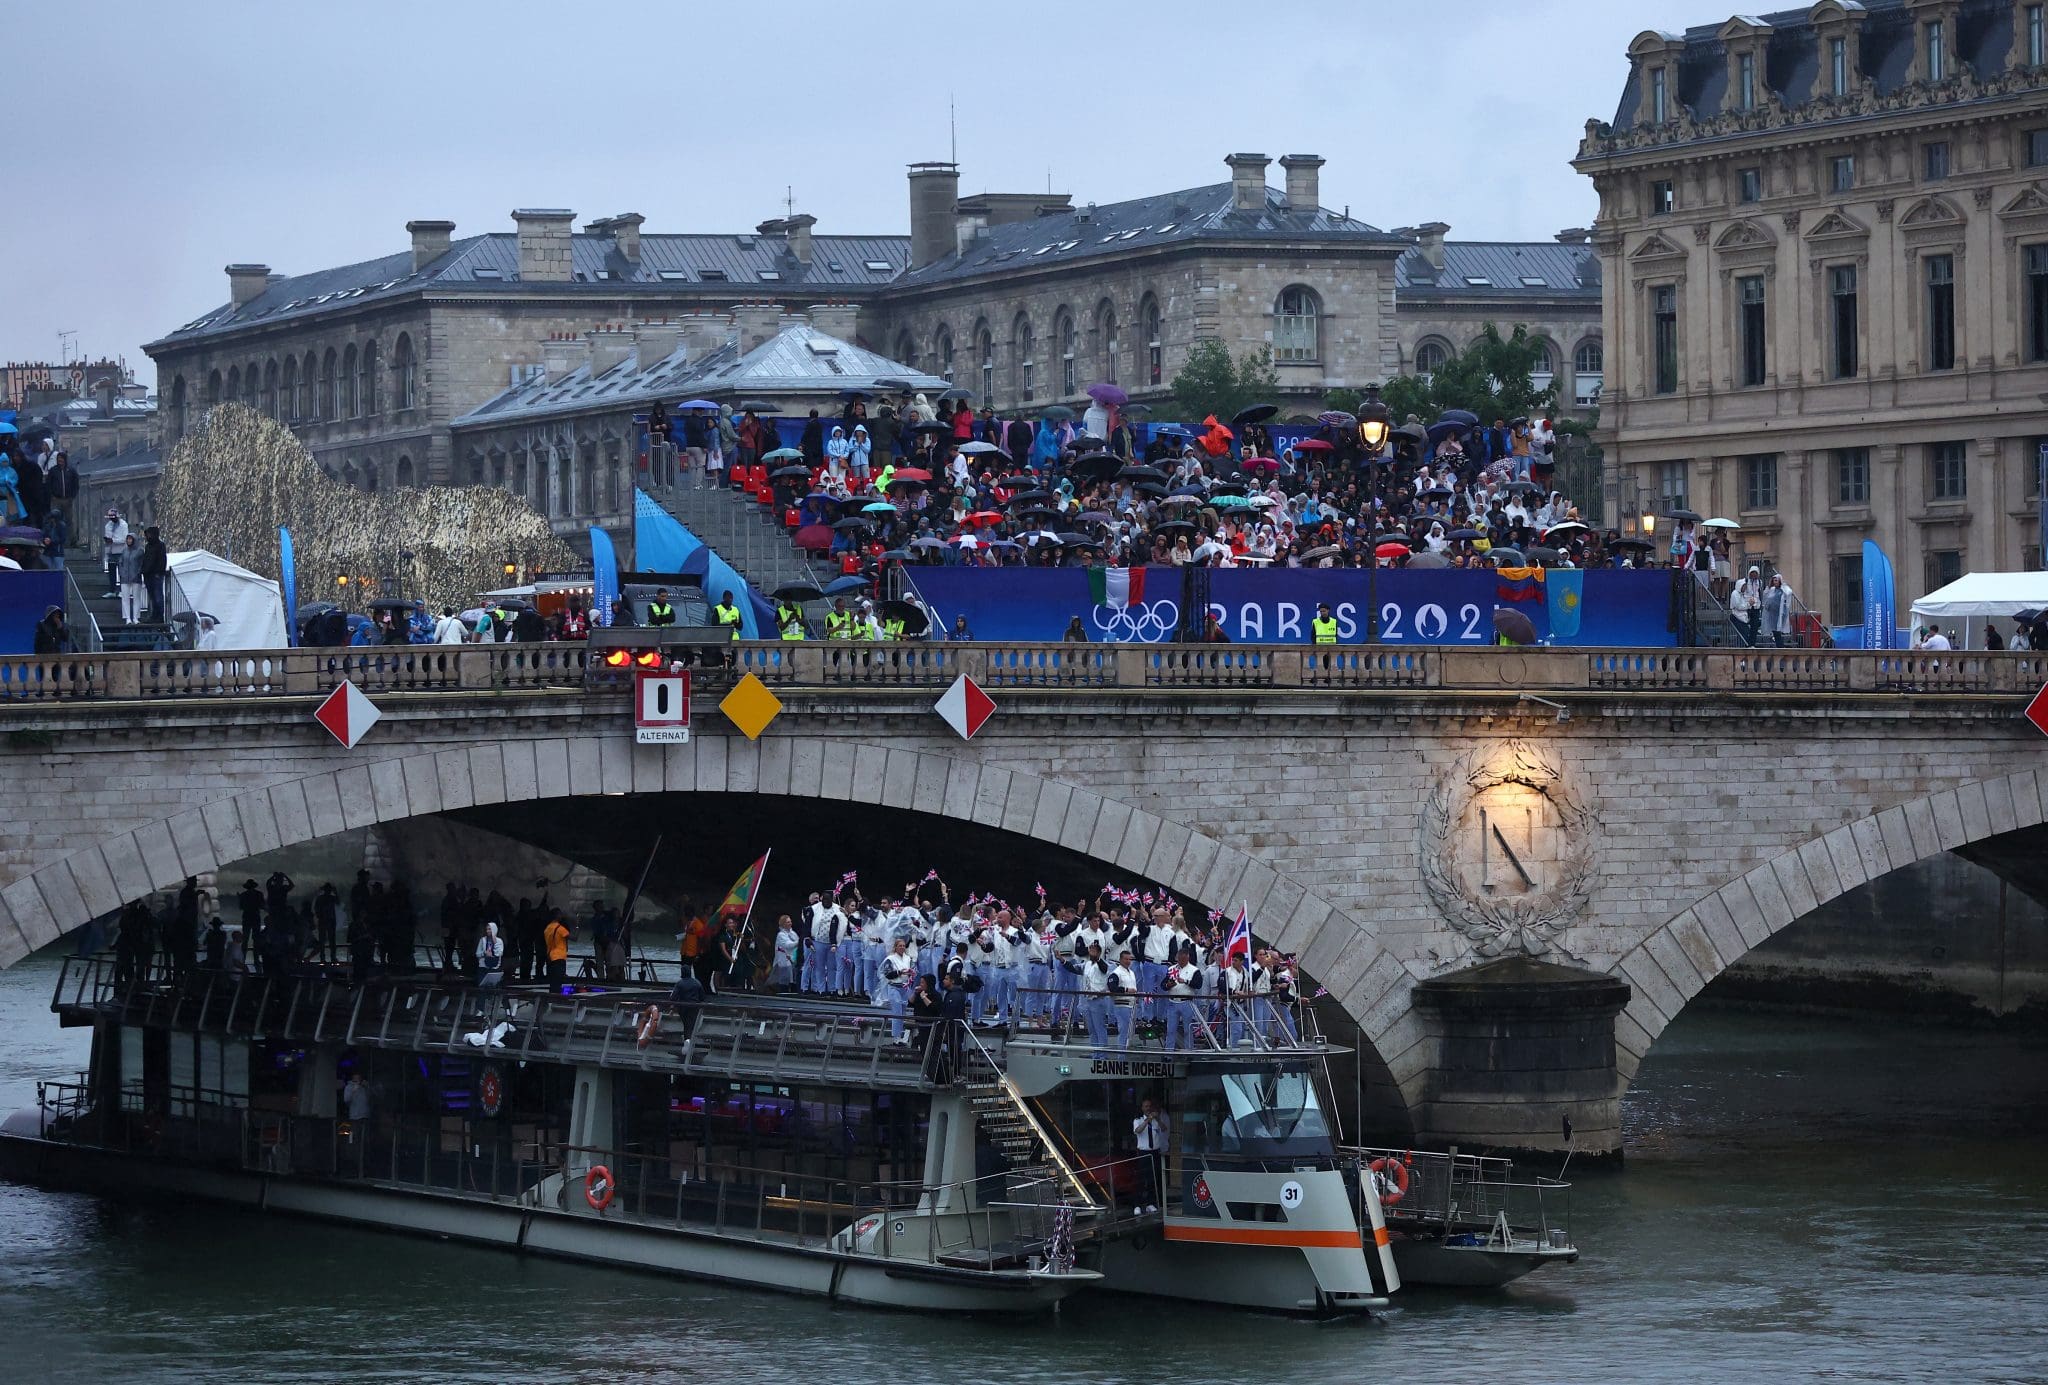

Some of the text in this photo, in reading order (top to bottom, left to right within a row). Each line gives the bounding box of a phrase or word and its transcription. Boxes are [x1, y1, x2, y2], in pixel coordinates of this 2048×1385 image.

[640, 731, 686, 740] ALTERNAT
[1090, 1060, 1175, 1078] JEANNE MOREAU
[1284, 1187, 1298, 1201] 31
